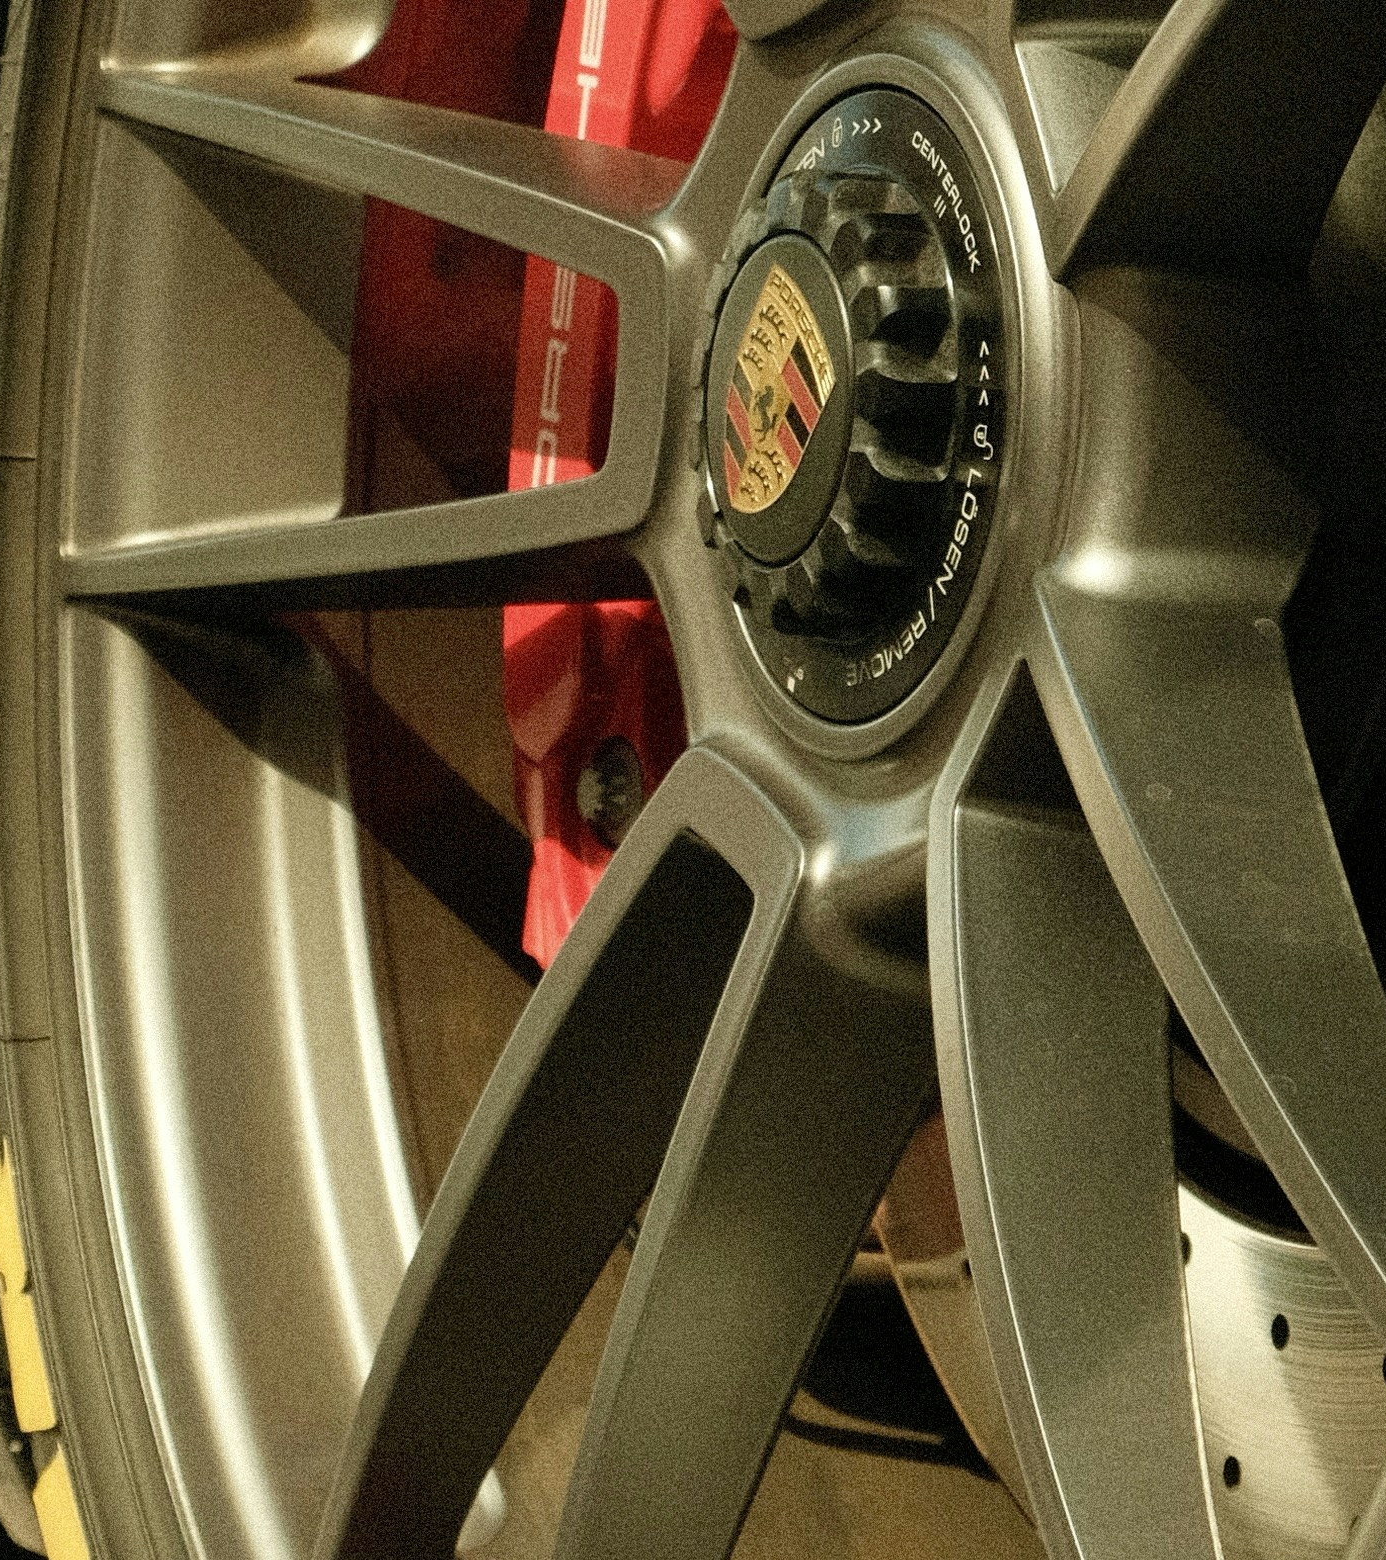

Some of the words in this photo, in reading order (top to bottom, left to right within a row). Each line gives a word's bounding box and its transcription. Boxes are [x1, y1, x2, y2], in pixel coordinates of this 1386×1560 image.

[912, 131, 981, 274] CENTERLOCK
[769, 271, 836, 403] PORSCHE
[935, 468, 982, 596] LÖSEN
[847, 610, 928, 687] REMOVE
